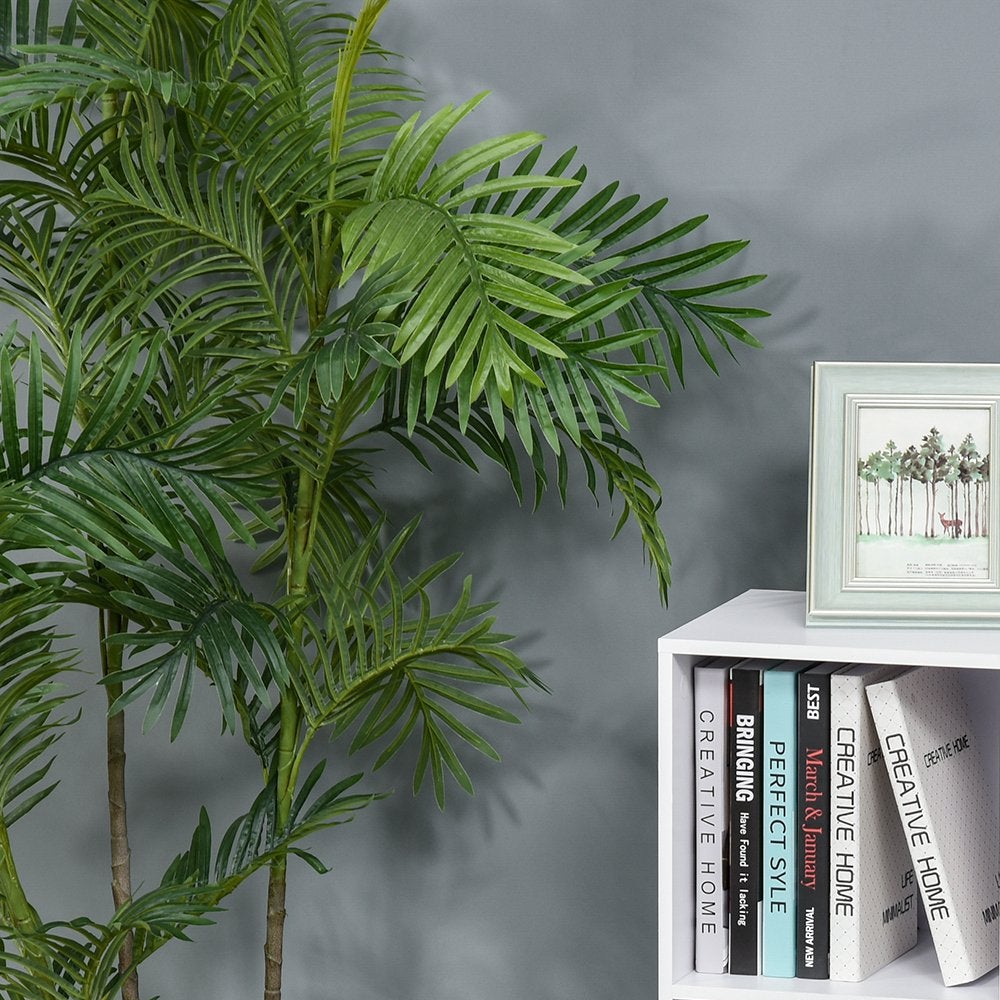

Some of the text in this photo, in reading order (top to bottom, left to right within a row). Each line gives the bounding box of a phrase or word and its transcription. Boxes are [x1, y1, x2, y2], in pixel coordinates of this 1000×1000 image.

[806, 684, 820, 720] BEST
[923, 744, 952, 768] CREATIVE
[699, 710, 716, 935] CREATIVE HOME
[736, 714, 754, 926] BRINGING Have Found it lacking
[769, 741, 787, 914] PERFECT SYLE
[802, 748, 823, 891] March & January
[835, 727, 855, 917] CREATIVE HOME
[885, 733, 950, 922] CREATIVE HOME
[805, 906, 814, 968] NEW ARRIVAL
